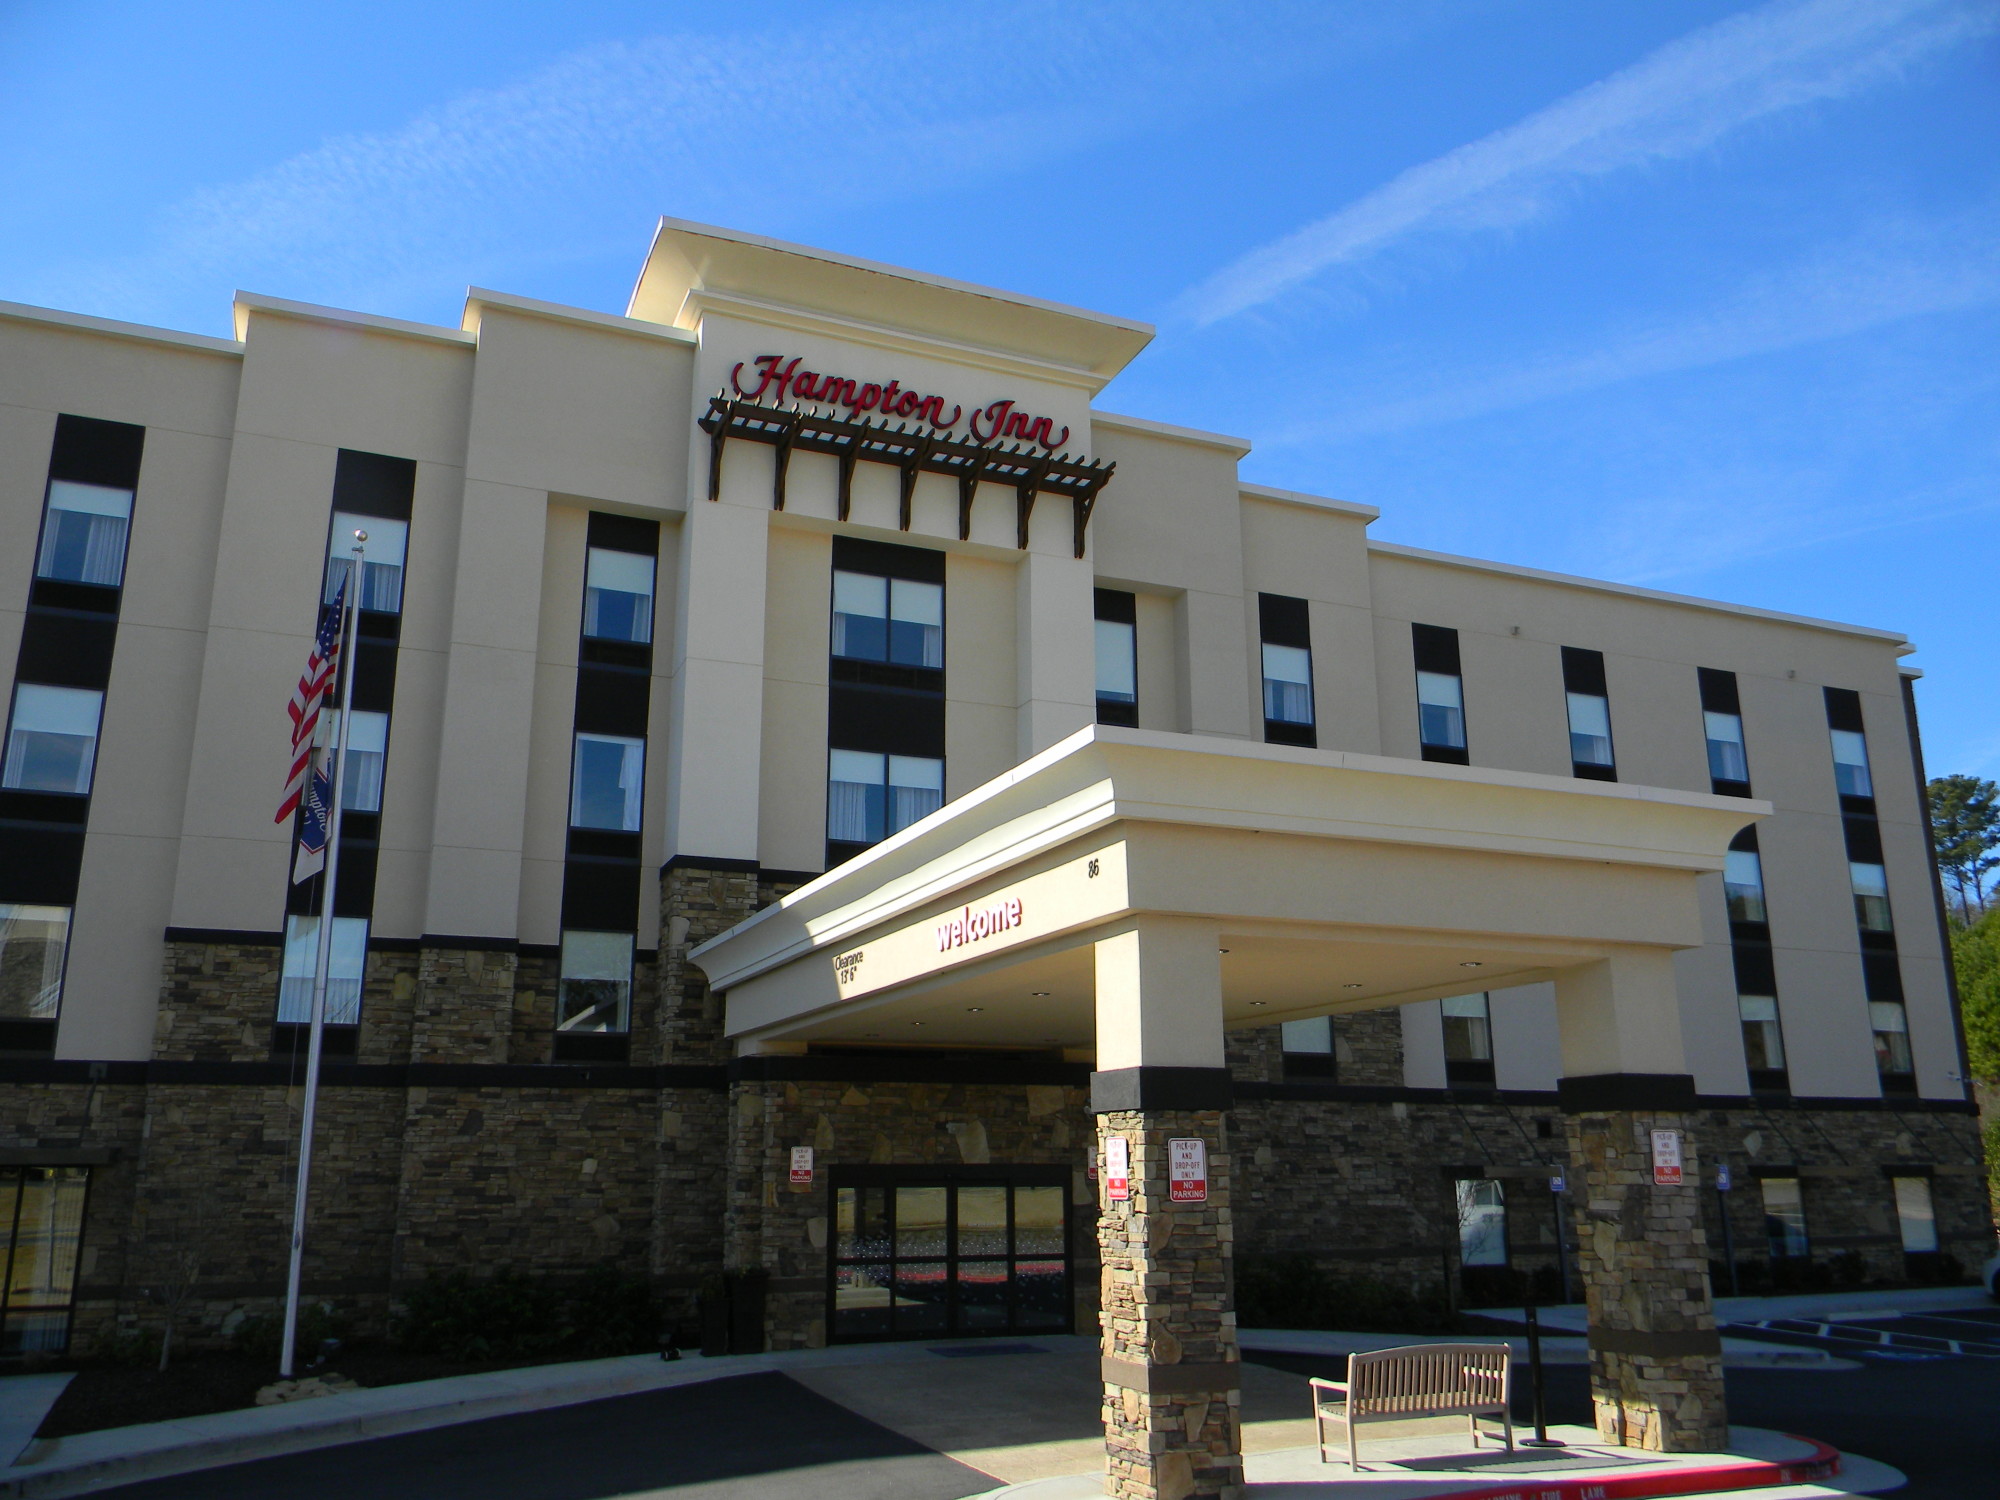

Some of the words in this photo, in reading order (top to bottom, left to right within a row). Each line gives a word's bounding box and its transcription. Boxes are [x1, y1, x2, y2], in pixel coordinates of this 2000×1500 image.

[731, 355, 962, 430] Hampton
[970, 400, 1070, 451] Inn
[1088, 858, 1099, 879] 86
[936, 897, 1022, 952] welcome
[835, 951, 864, 971] Clearance
[1176, 1142, 1197, 1150] PICK-UP
[1182, 1152, 1192, 1160] AND
[1175, 1161, 1200, 1169] DROP-OFF
[1181, 1171, 1195, 1179] ONLY
[1183, 1181, 1194, 1189] NO
[1173, 1190, 1205, 1198] PARKING
